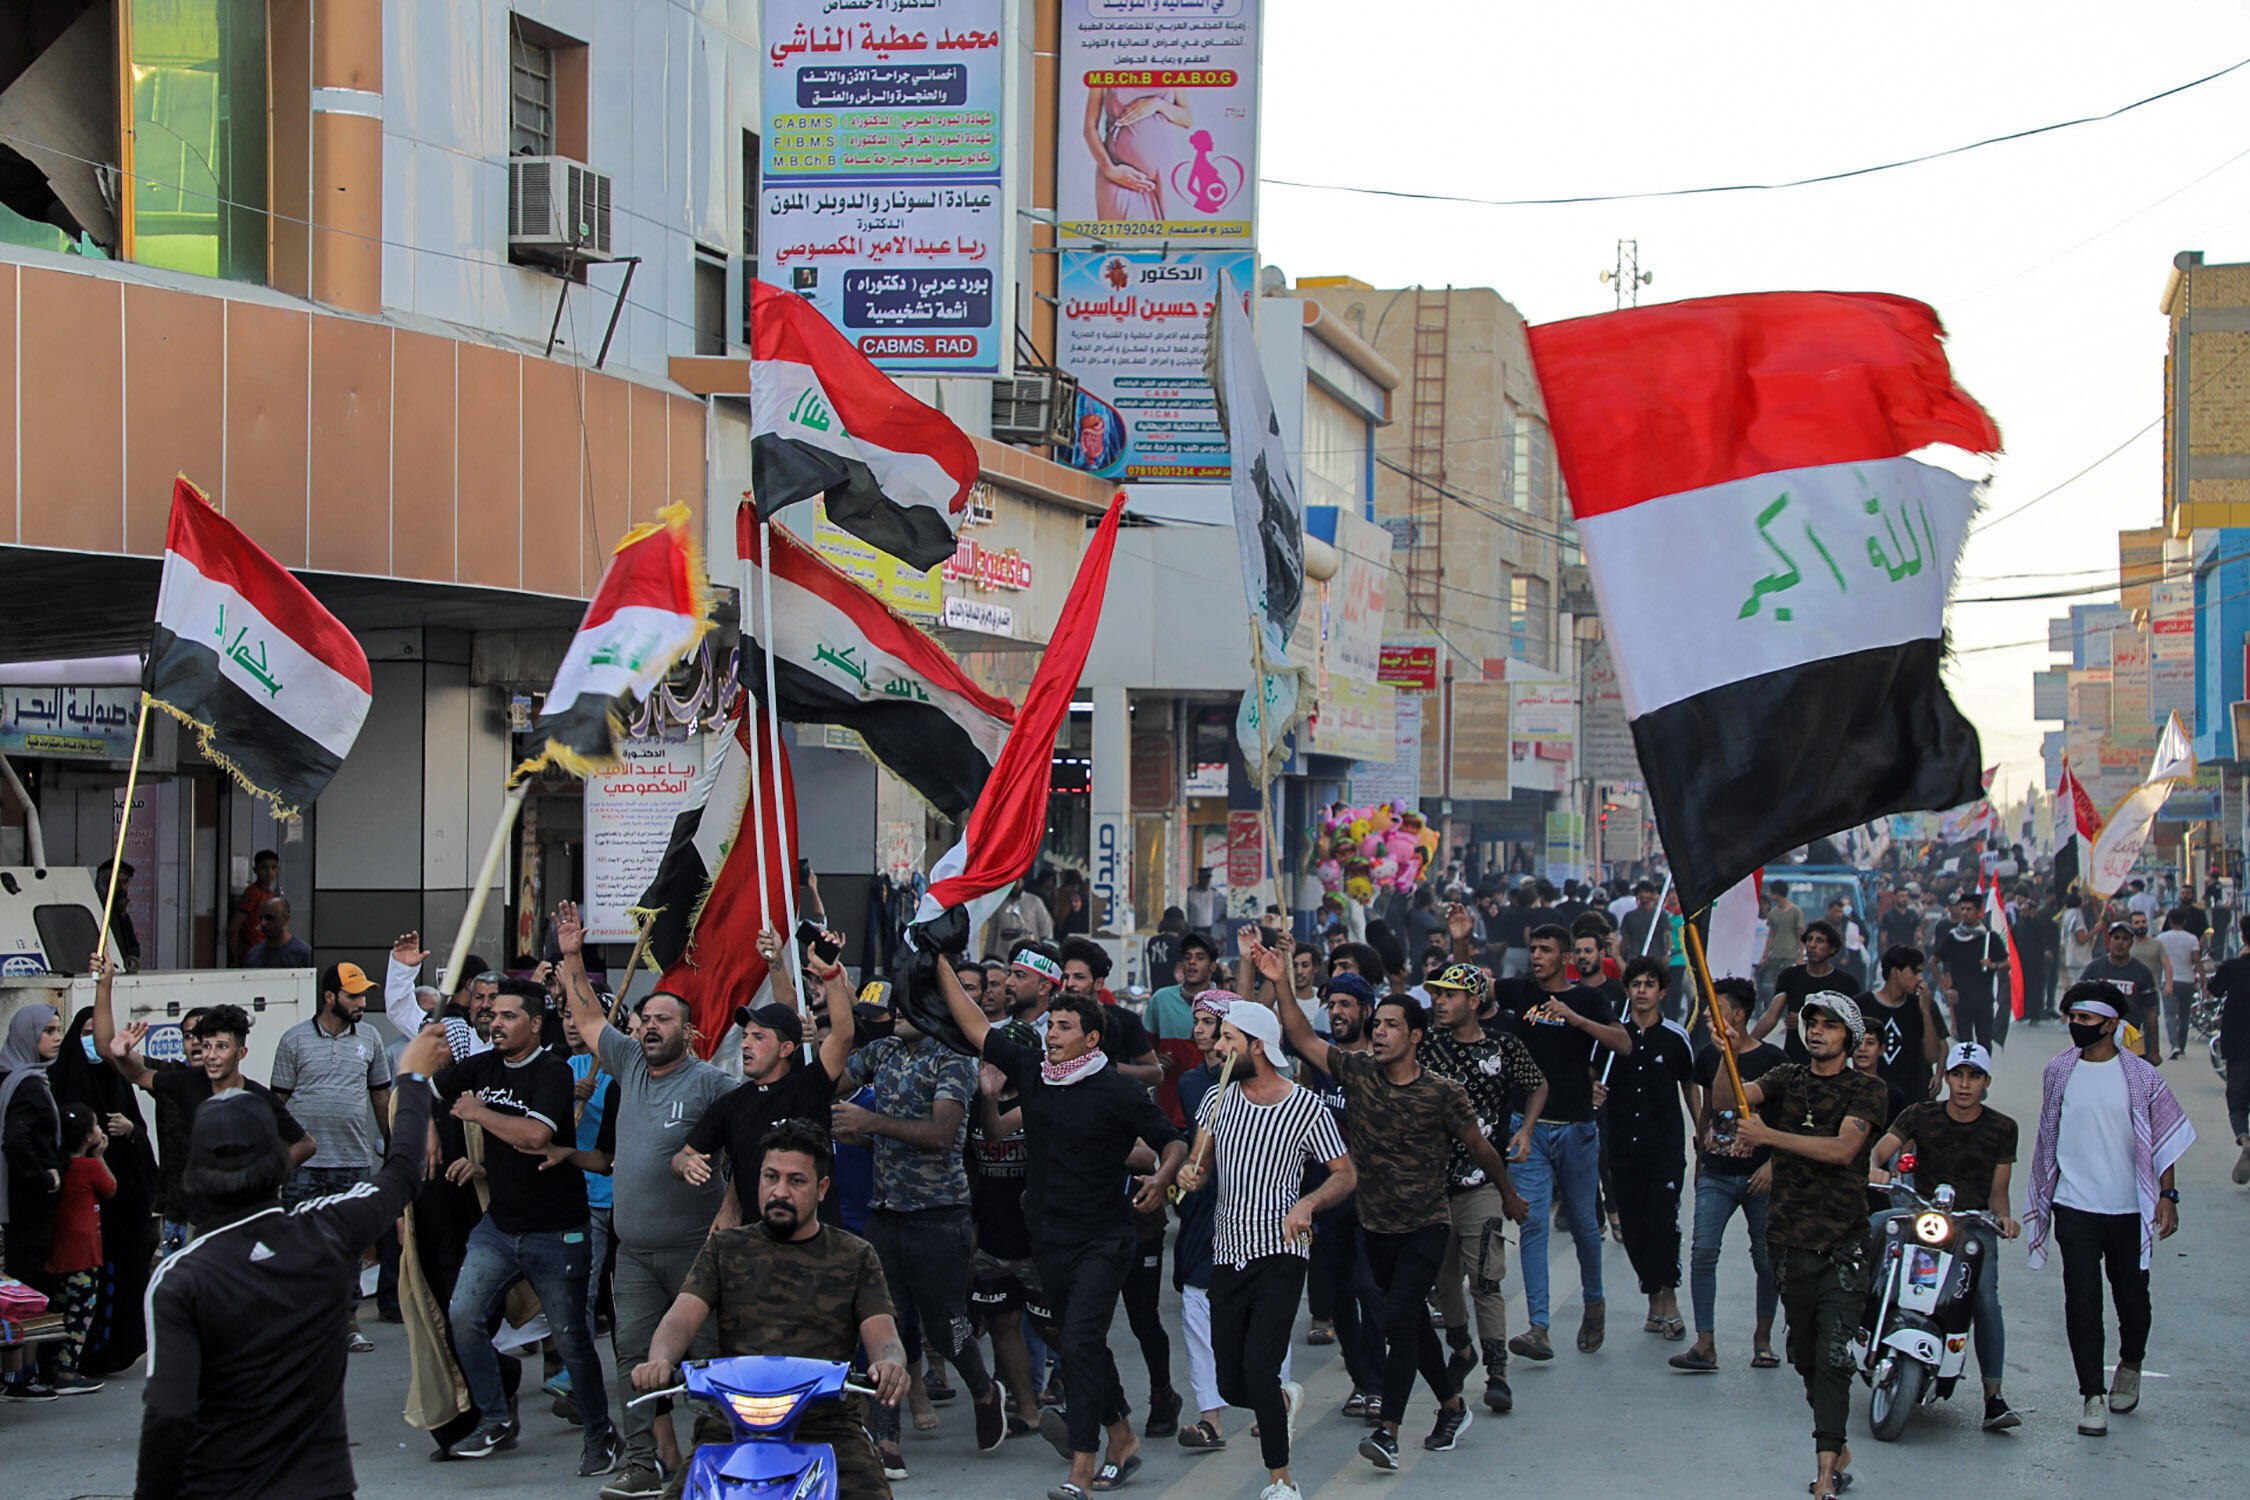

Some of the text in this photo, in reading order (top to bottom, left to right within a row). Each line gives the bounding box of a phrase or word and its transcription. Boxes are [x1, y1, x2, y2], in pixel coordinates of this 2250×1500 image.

[770, 22, 999, 67] محمد عطية الناشي
[872, 70, 911, 86] جراحة
[1088, 71, 1232, 85] M.B.Ch.B C.A.B.O.G
[811, 93, 854, 105] والعنق
[895, 89, 948, 104] والحنجرة
[773, 117, 834, 129] C.A.B.M.S
[773, 135, 835, 147] F.I.B.M.S
[773, 155, 837, 167] M.B.Ch.B
[770, 190, 992, 215] عيادة السونار والدوبلر الملون
[857, 218, 904, 232] الدكتورة
[1075, 224, 1164, 235] 07821792042
[775, 235, 862, 266] المكصوصي
[957, 235, 986, 260] ريا
[1139, 266, 1203, 284] الدكتور
[920, 276, 957, 298] عربي
[959, 276, 988, 296] بورد
[866, 301, 968, 324] أشعة تشخيصية
[1065, 295, 1137, 321] الياسين
[1140, 298, 1198, 322] حسين
[935, 339, 973, 354] RAD
[1866, 497, 1938, 582] الله
[14, 687, 127, 734] صيدلية البحر
[622, 748, 666, 760] الدكتورة
[668, 762, 696, 778] ريا
[603, 778, 688, 797] المكصوصي
[1320, 1086, 1347, 1110] Emir
[976, 1141, 1028, 1161] ESIGN
